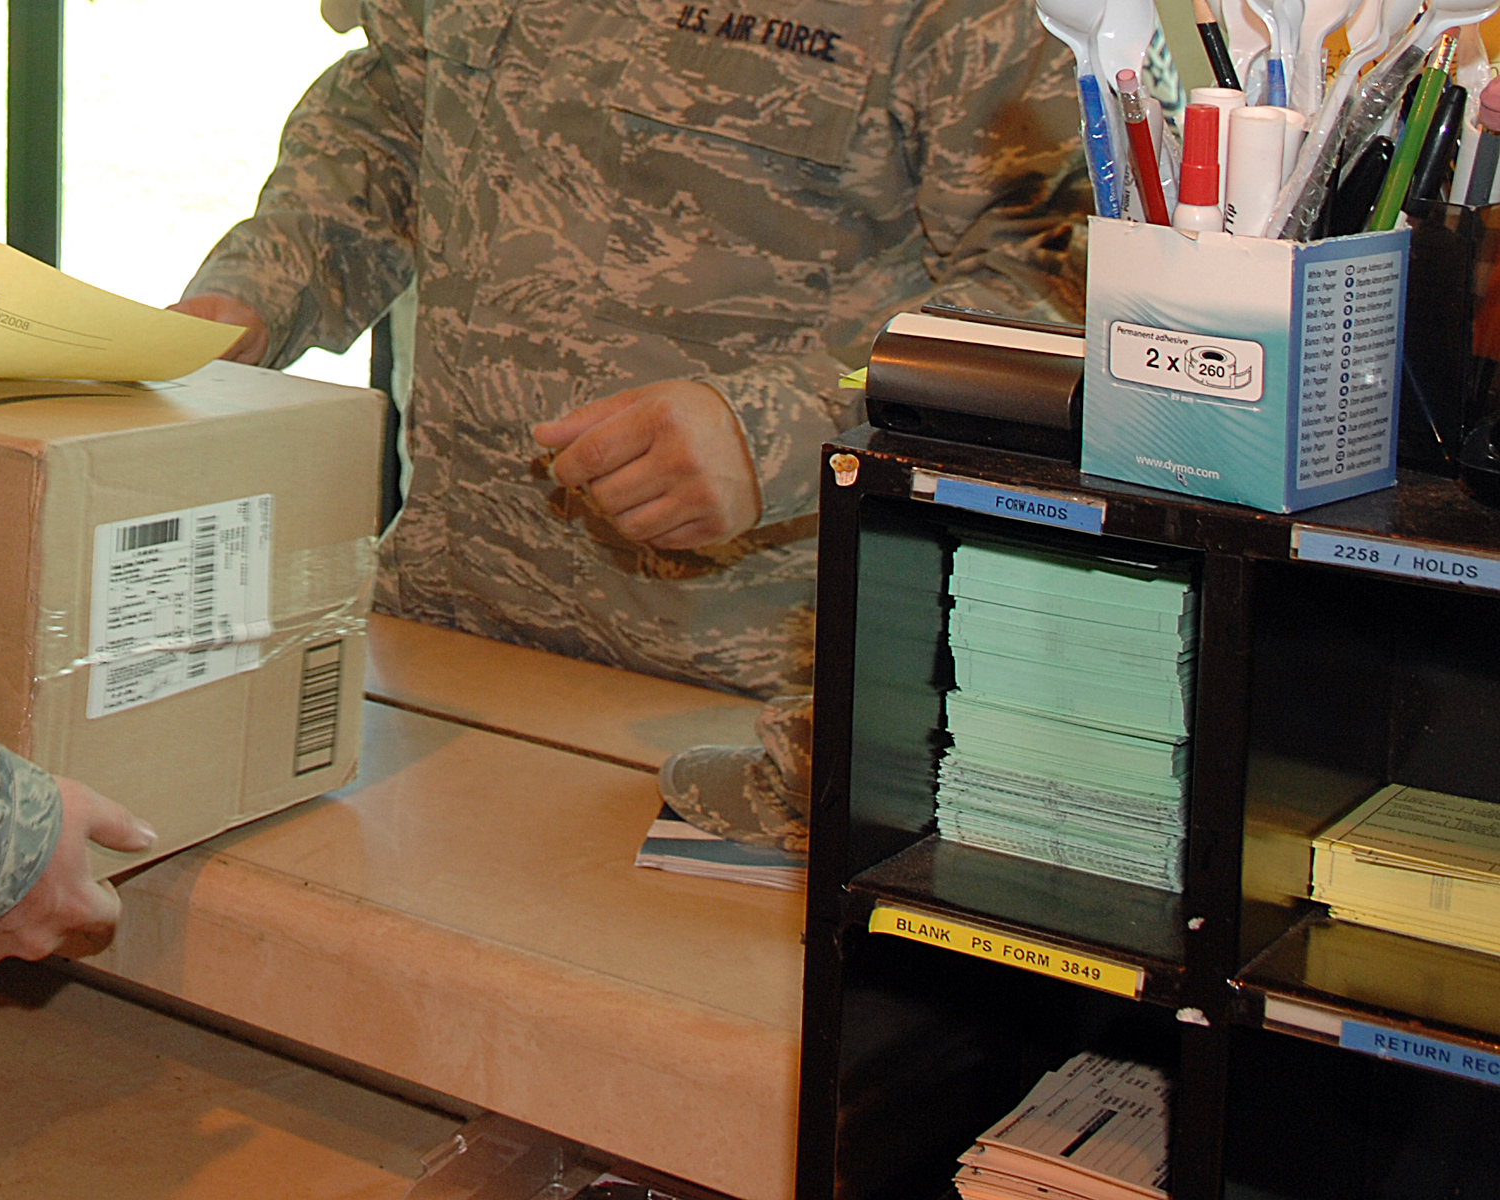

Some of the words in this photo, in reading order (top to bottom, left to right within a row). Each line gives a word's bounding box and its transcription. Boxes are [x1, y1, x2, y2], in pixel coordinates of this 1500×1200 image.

[676, 6, 707, 35] U.S.
[716, 12, 757, 42] AIR
[762, 18, 843, 63] FORCE
[1226, 203, 1237, 224] Tip
[1116, 325, 1155, 341] Permanent
[1155, 332, 1189, 346] adhesive
[1146, 347, 1160, 369] 2
[1167, 355, 1180, 373] x
[1199, 363, 1225, 378] 260
[1136, 455, 1221, 480] www.dymo.com
[995, 495, 1068, 521] FORWARDS
[1334, 544, 1380, 563] 2258
[1393, 554, 1400, 566] /
[1413, 556, 1479, 579] HOLDS
[896, 917, 951, 943] BLANK
[971, 936, 993, 953] PS
[1002, 944, 1050, 968] FORM
[1061, 960, 1102, 981] 3849
[1374, 1033, 1451, 1063] RETURN
[1462, 1054, 1500, 1076] REC
